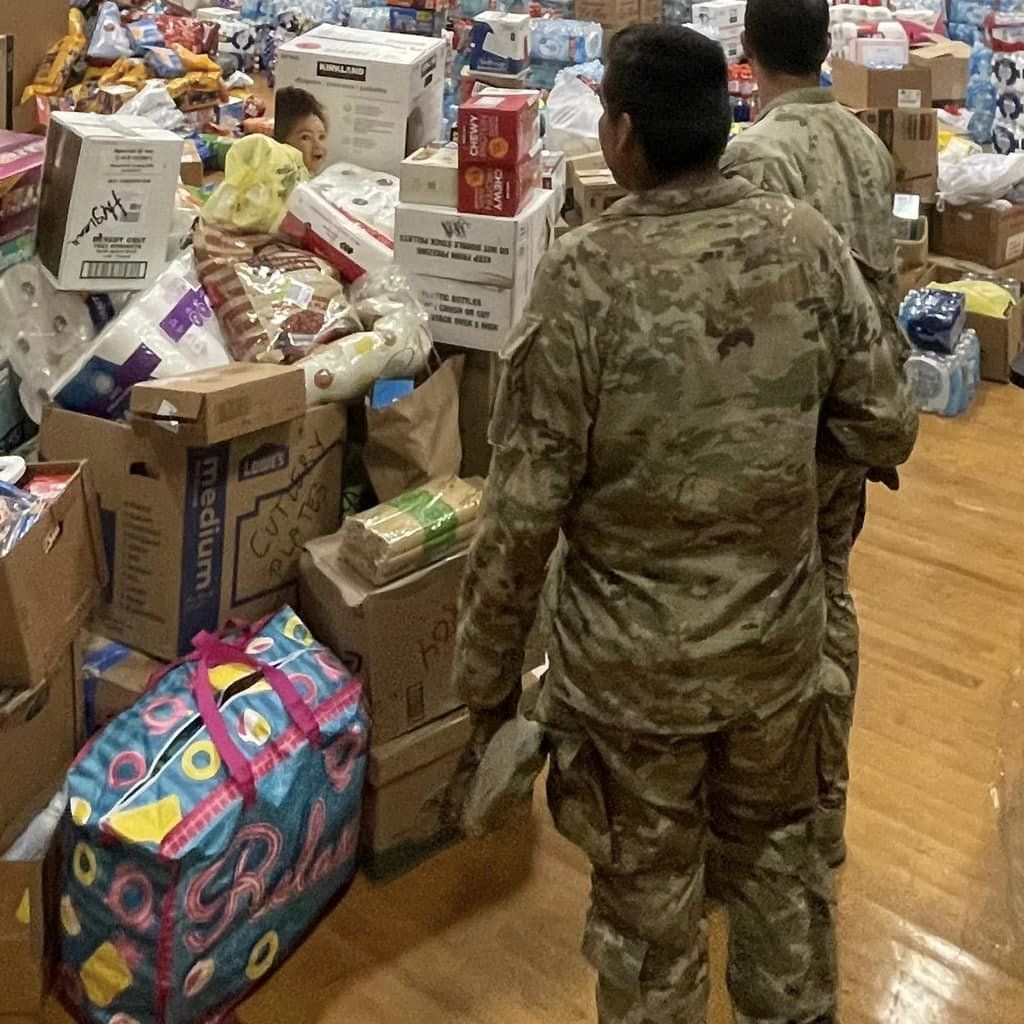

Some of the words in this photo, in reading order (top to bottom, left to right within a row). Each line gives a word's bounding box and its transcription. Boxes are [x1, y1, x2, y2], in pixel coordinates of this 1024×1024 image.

[319, 62, 364, 77] KIRKLAND
[469, 114, 479, 157] CHEWY
[494, 169, 504, 211] CHEWY
[195, 457, 219, 590] medium
